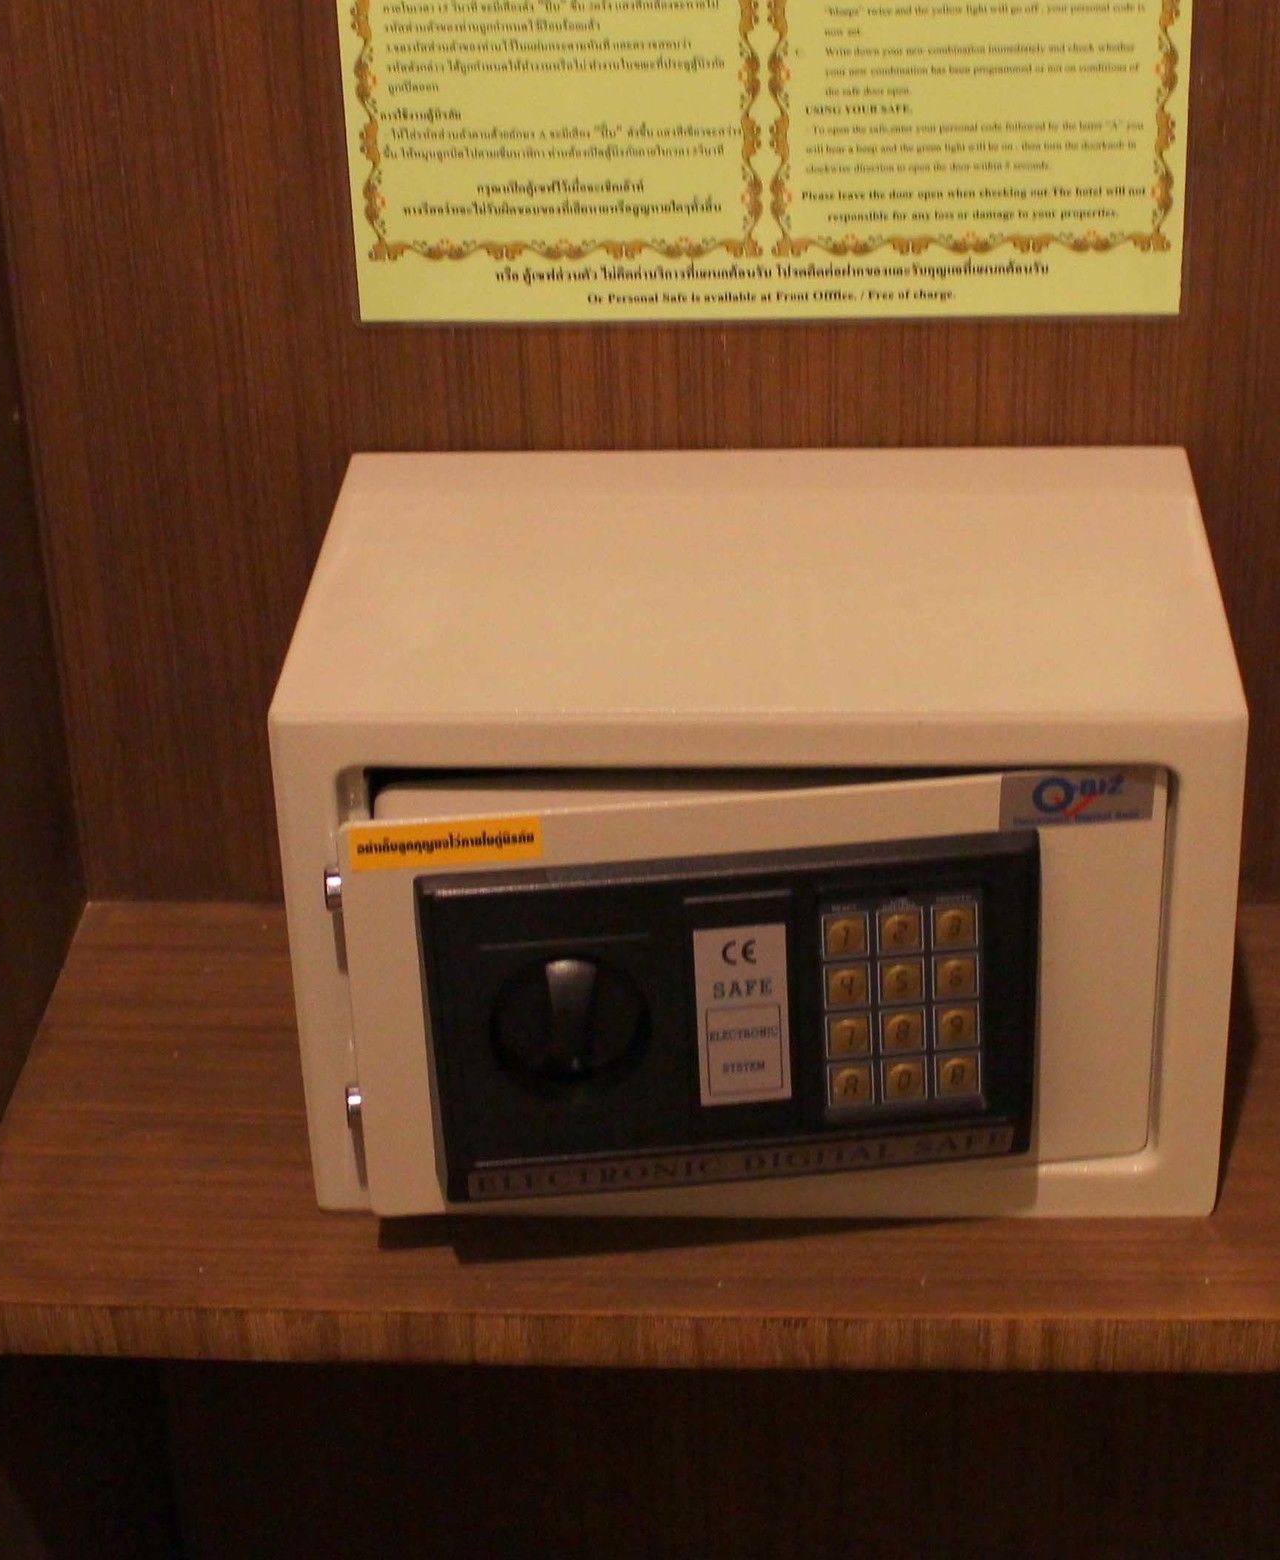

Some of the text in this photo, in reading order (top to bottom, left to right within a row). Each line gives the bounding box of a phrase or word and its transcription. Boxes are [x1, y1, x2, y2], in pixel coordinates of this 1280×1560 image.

[895, 7, 911, 15] and
[915, 6, 929, 14] the
[932, 5, 962, 16] yellow
[967, 5, 987, 15] light
[991, 4, 1007, 13] will
[1011, 5, 1020, 15] go
[1047, 4, 1066, 14] your
[1071, 4, 1109, 14] personal
[1113, 3, 1134, 12] code
[826, 42, 1134, 58] Write down your new combination immediately and check whether
[826, 69, 845, 77] your
[871, 66, 927, 75] combination
[931, 65, 945, 74] has
[949, 65, 970, 74] been
[973, 64, 1031, 76] programmed
[1036, 65, 1043, 73] or
[1048, 64, 1061, 72] not
[1065, 64, 1075, 72] on
[1080, 62, 1126, 72] conditions
[1130, 62, 1139, 71] of
[826, 88, 839, 96] the
[843, 87, 859, 96] safe
[864, 86, 883, 96] door
[806, 105, 841, 115] USING
[846, 104, 877, 115] YOUR
[827, 126, 849, 136] open
[853, 124, 866, 133] the
[916, 124, 935, 134] your
[939, 123, 977, 134] personal
[981, 122, 1001, 131] code
[1006, 121, 1045, 131] followed
[1049, 121, 1058, 132] by
[1063, 120, 1075, 129] the
[1080, 120, 1102, 129] letter
[806, 145, 823, 154] will
[826, 145, 845, 153] hear
[857, 144, 877, 155] beep
[881, 144, 896, 153] and
[900, 143, 913, 152] the
[917, 145, 941, 155] green
[945, 143, 965, 153] light
[969, 142, 985, 151] will
[988, 142, 998, 151] be
[1022, 141, 1041, 150] then
[1044, 141, 1061, 150] turn
[1065, 141, 1078, 150] the
[806, 164, 850, 173] clockwise
[854, 164, 894, 173] direction
[897, 163, 905, 172] to
[909, 164, 930, 175] open
[934, 162, 947, 171] the
[950, 162, 969, 171] door
[974, 161, 1002, 171] within
[802, 190, 833, 200] Please
[839, 190, 865, 199] leave
[869, 189, 884, 199] the
[889, 189, 912, 198] door
[918, 190, 943, 202] open
[948, 188, 975, 198] when
[980, 187, 1026, 199] checking
[1076, 185, 1102, 196] hotel
[1107, 185, 1125, 195] will
[1129, 185, 1146, 195] not
[828, 211, 888, 223] responsible
[893, 211, 906, 220] for
[912, 212, 930, 222] any
[935, 210, 954, 220] loss
[958, 212, 968, 220] or
[973, 209, 1014, 222] damage
[1019, 210, 1028, 219] to
[1033, 210, 1055, 219] your
[588, 293, 603, 303] Or
[608, 293, 658, 303] Personal
[663, 293, 687, 303] Safe
[692, 293, 700, 302] is
[705, 292, 756, 302] available
[761, 292, 770, 302] at
[777, 291, 808, 301] Front
[869, 290, 893, 300] Free
[899, 290, 910, 299] of
[914, 290, 956, 303] charge.
[722, 939, 757, 966] CE
[713, 979, 772, 999] SAFE
[707, 1026, 779, 1042] ELECTRONIC
[722, 1060, 765, 1075] SYSTEM
[476, 1129, 1009, 1195] ELECTRONIC DIGITAL SAFE
